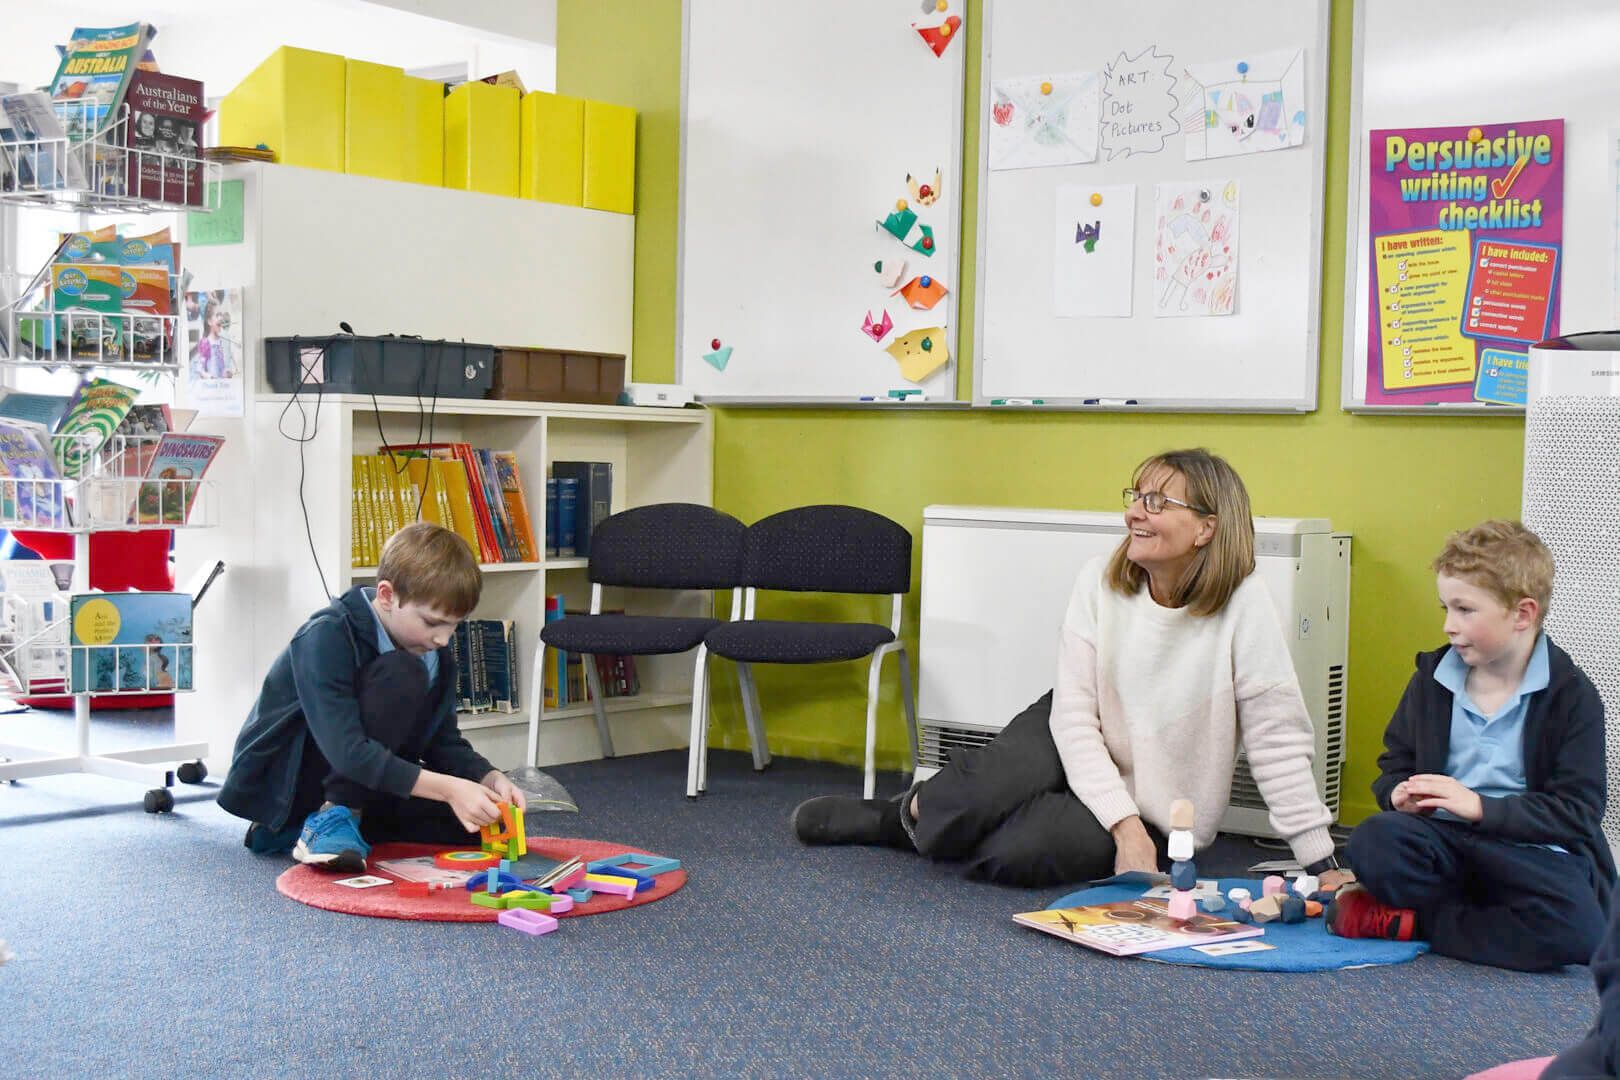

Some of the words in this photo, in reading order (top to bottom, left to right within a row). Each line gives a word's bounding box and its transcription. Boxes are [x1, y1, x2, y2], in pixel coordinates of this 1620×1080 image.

[64, 55, 128, 74] AUSTRALIA
[136, 83, 198, 104] Australians
[143, 98, 151, 108] of
[153, 100, 167, 110] the
[167, 100, 191, 114] Year
[1111, 101, 1133, 116] Dot
[1112, 121, 1162, 138] Pictures
[1385, 129, 1551, 172] Persuasive
[1400, 171, 1488, 201] writing
[1439, 199, 1543, 231] checklist
[1387, 241, 1408, 251] have
[1488, 246, 1509, 259] have
[1510, 248, 1549, 263] included:
[1494, 356, 1513, 368] have
[160, 442, 215, 459] DINOSAURS
